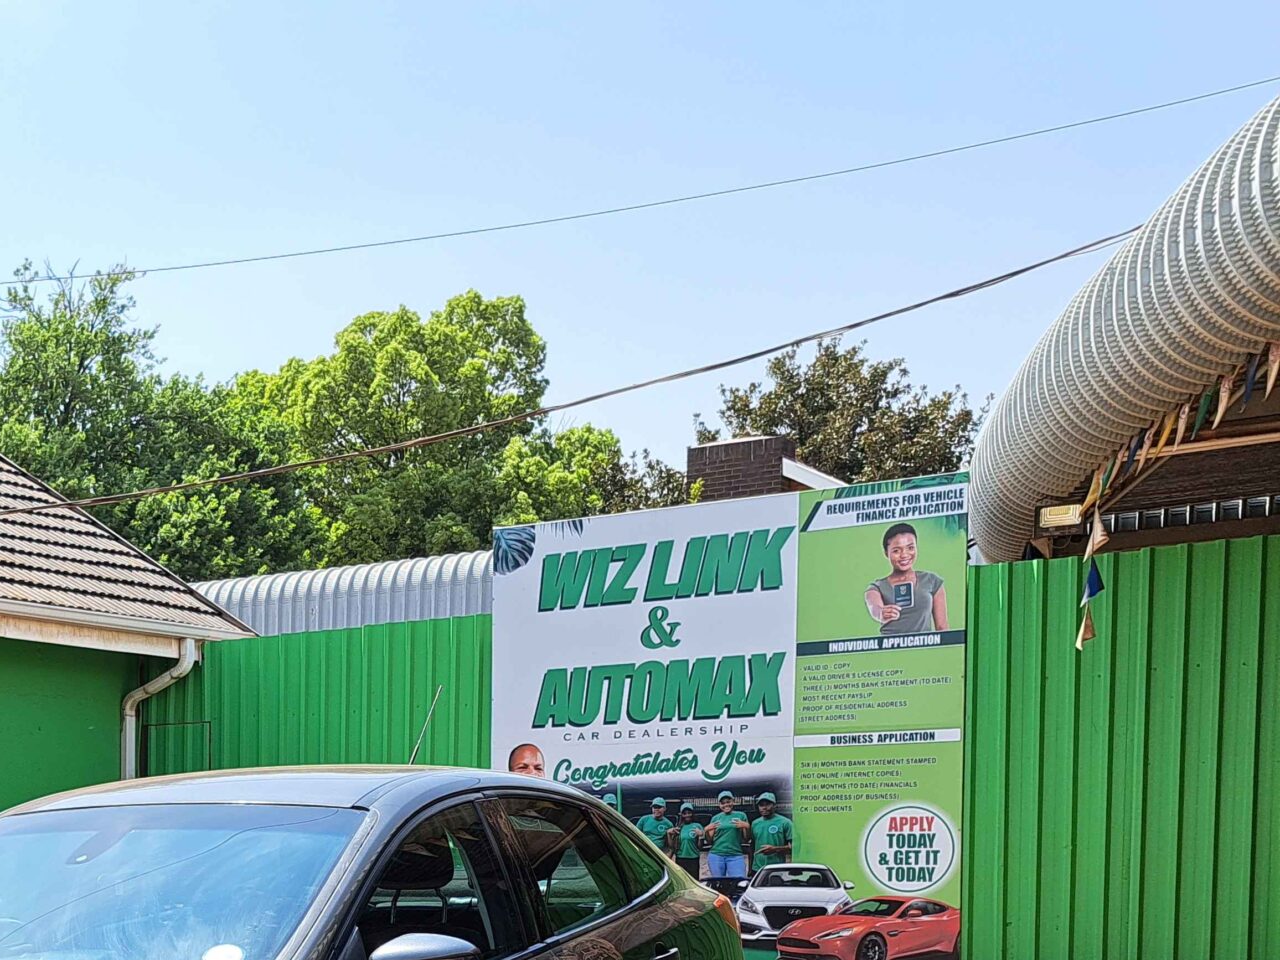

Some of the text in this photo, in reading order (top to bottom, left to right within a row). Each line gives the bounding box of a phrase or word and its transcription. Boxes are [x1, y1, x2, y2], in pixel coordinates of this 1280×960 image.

[827, 488, 964, 515] REQUIREMENTS FOR VEHICLE
[856, 500, 964, 523] FINANCE APPLICATION
[538, 525, 796, 612] WIZ LINK
[640, 605, 681, 649] &
[829, 634, 941, 652] INDIVIDUAL APPLICATION
[803, 664, 821, 672] VALID
[834, 662, 850, 670] COPY
[808, 674, 826, 682] VALID
[857, 670, 884, 679] LICENSE
[886, 670, 904, 678] COPY
[532, 652, 786, 728] AUTOMAX
[803, 684, 823, 692] THREE
[833, 682, 860, 690] MONTHS
[861, 680, 879, 689] BANK
[880, 678, 918, 688] STATEMENT
[802, 694, 820, 702] MOST
[821, 692, 846, 701] RECENT
[824, 704, 834, 712] OF
[835, 702, 875, 711] RESIDENTIAL
[877, 700, 907, 708] ADDRESS
[563, 724, 749, 742] CAR DEALERSHIP
[830, 731, 935, 745] BUSINESS APPLICATION
[553, 740, 766, 788] Congratulates You
[820, 760, 847, 768] MONTHS
[848, 760, 866, 768] BANK
[868, 758, 904, 766] STATEMENT
[906, 757, 936, 765] STAMPED
[816, 772, 839, 780] ONLINE
[820, 782, 846, 790] MONTHS
[800, 794, 820, 802] PROOF
[888, 816, 935, 832] APPLY
[886, 833, 936, 848] TODAY
[878, 850, 940, 865] & GET IT
[886, 867, 936, 882] TODAY
